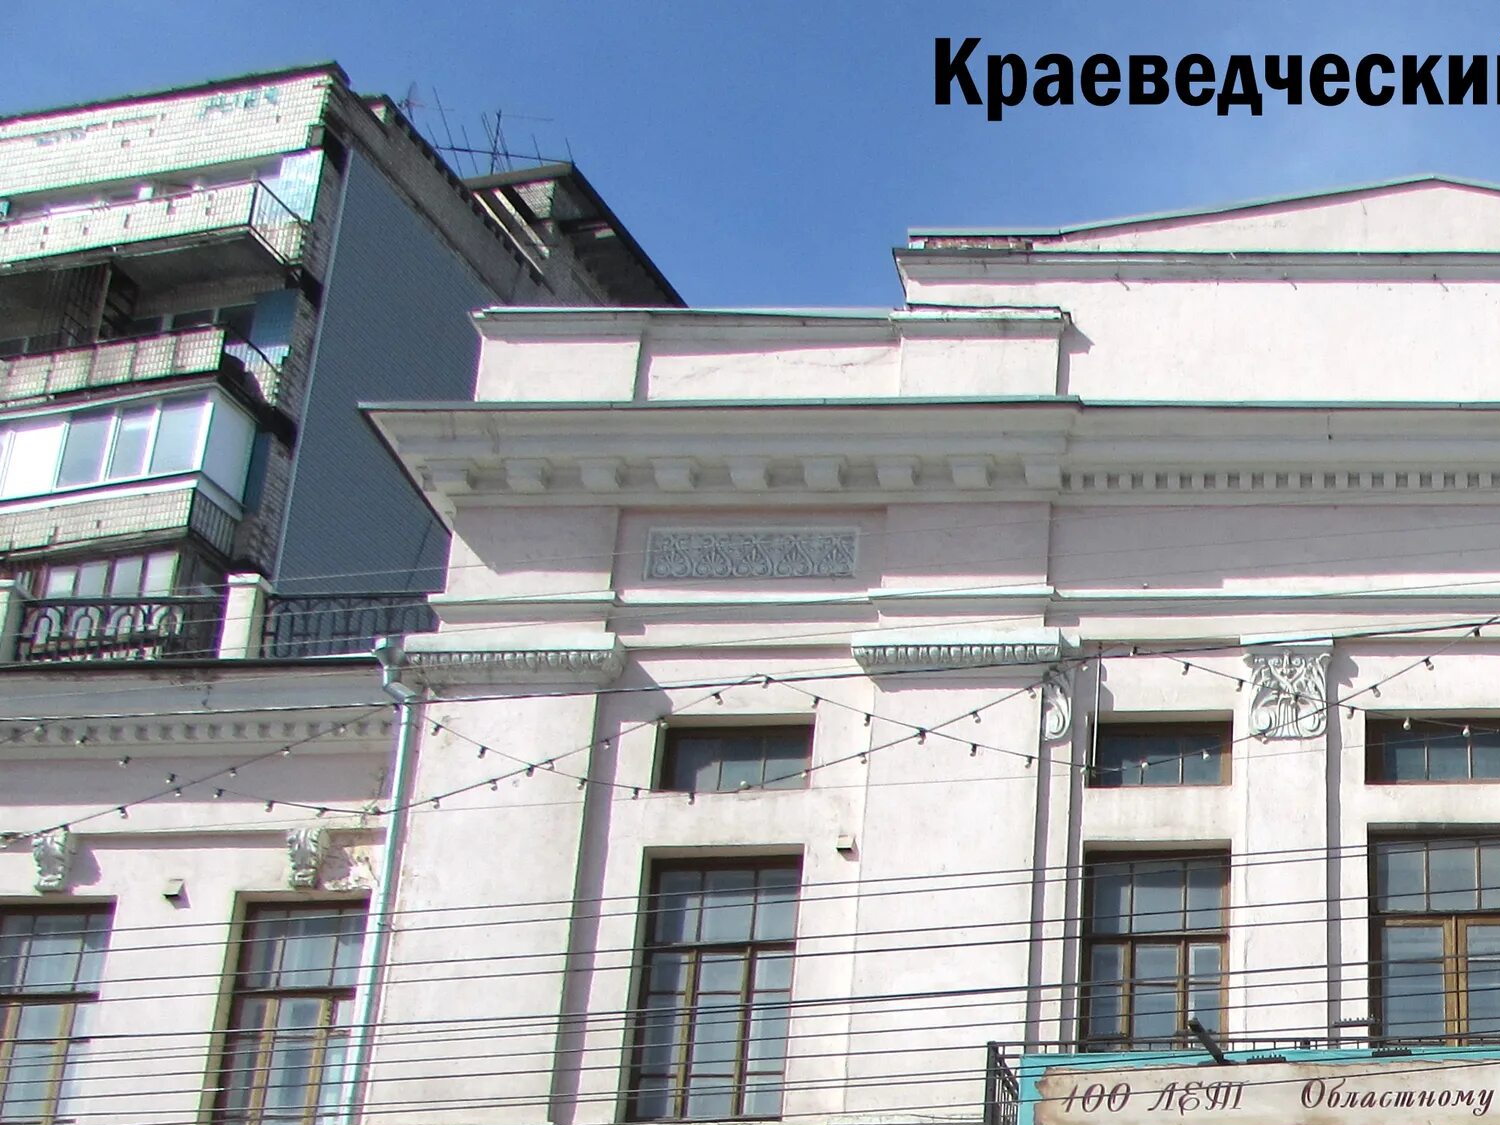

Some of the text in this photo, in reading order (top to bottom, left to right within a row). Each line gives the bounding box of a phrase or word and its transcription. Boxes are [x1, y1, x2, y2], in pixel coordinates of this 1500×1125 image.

[1061, 1082, 1131, 1113] 100
[1147, 1080, 1249, 1115] ЛЕТ
[1301, 1077, 1495, 1117] Областному
